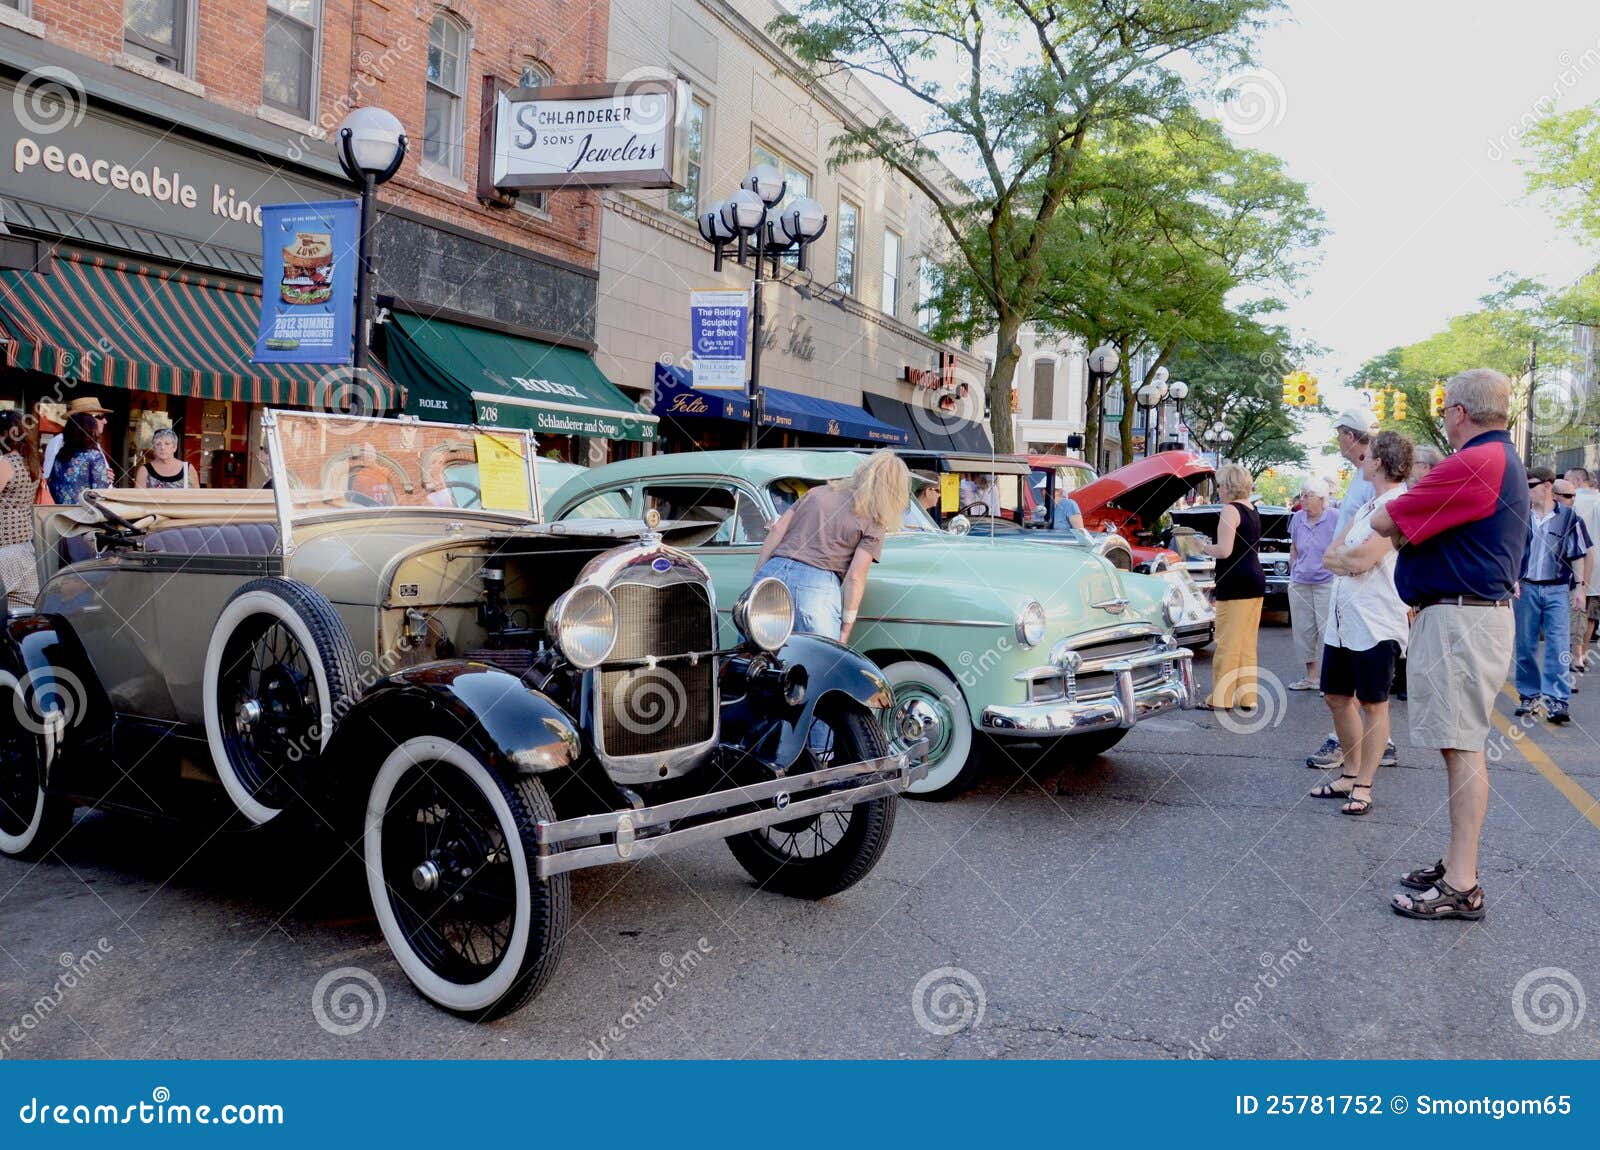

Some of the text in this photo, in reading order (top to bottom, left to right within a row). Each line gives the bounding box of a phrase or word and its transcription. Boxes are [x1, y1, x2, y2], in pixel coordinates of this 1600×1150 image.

[514, 104, 632, 149] SCHLANDERER
[543, 135, 574, 145] SONS
[566, 133, 657, 172] Jewelers
[14, 137, 199, 209] peaceable
[698, 308, 741, 318] The Rolling
[275, 317, 334, 329] 2012 SUMMER
[701, 319, 738, 328] Sculpture
[701, 329, 738, 337] Car Show
[511, 376, 589, 399] ROLEX
[419, 399, 448, 409] ROLEX
[666, 393, 709, 413] Felix
[480, 406, 498, 421] 208
[537, 413, 583, 431] Schlanderer
[584, 420, 597, 432] and
[641, 425, 654, 438] 208
